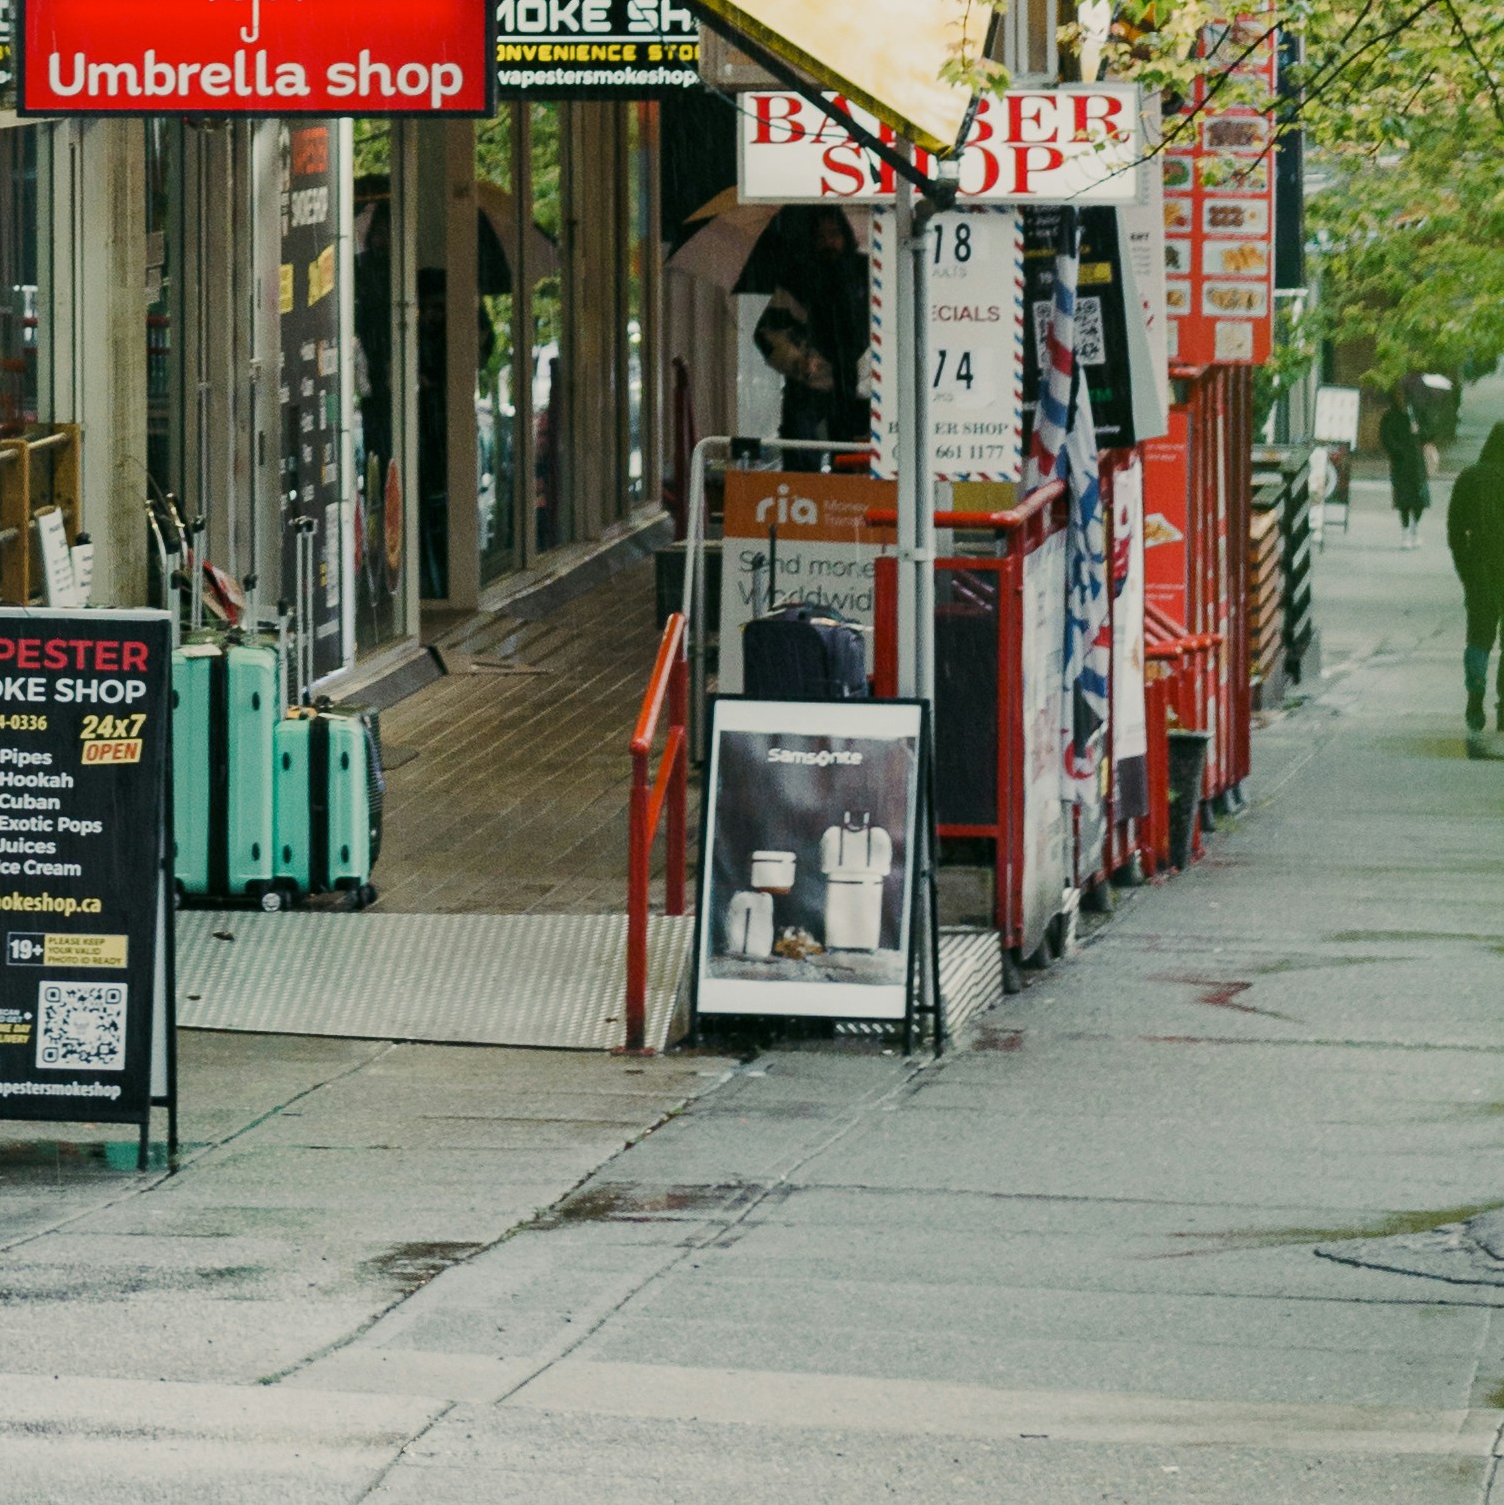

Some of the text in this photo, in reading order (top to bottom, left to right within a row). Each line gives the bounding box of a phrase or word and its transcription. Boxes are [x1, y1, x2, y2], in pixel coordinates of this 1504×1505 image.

[47, 47, 464, 106] Umbrella shop
[755, 483, 819, 525] ria
[53, 677, 147, 704] SHOP
[79, 713, 147, 740] 24x7
[85, 742, 139, 762] OPEN
[57, 817, 103, 836] Pops
[23, 860, 82, 876] Cream
[9, 939, 43, 960] 19+
[48, 936, 80, 945] PLEASE
[48, 946, 73, 955] YOUR
[92, 956, 122, 965] READY
